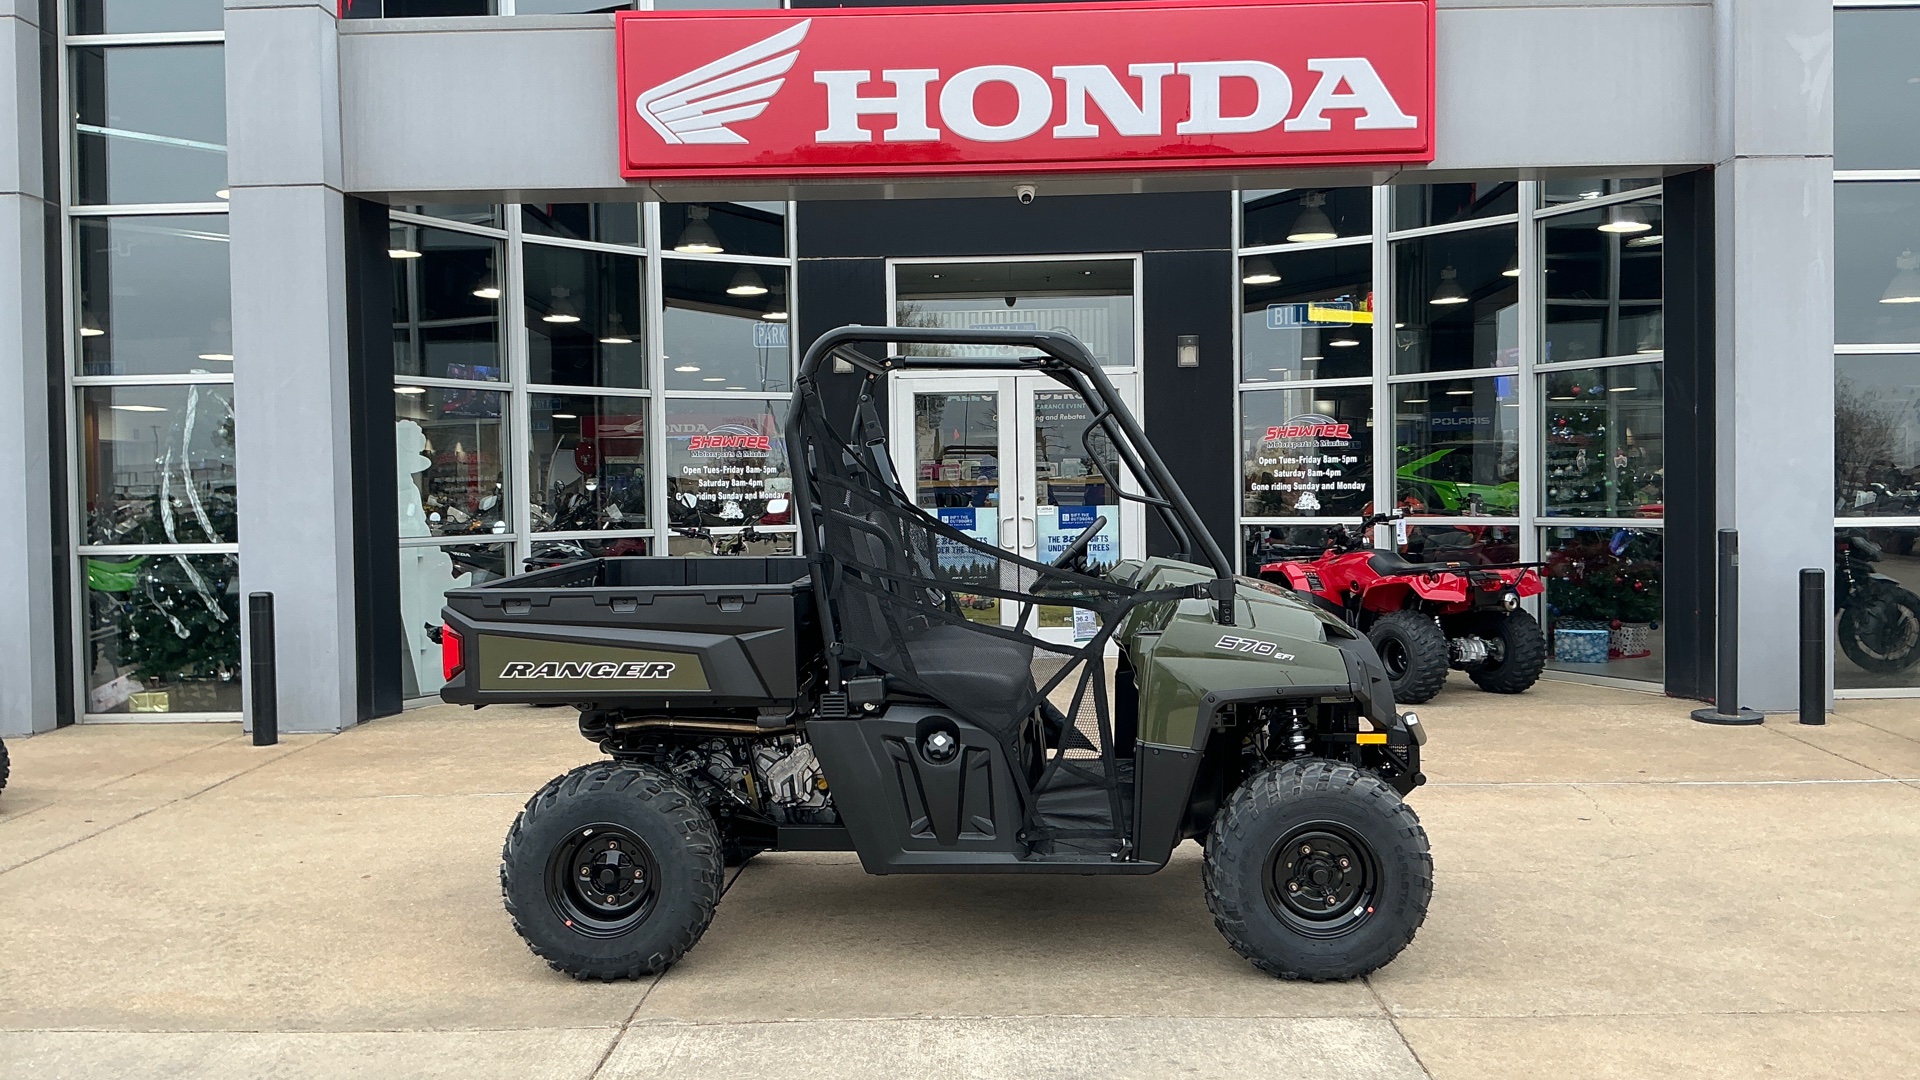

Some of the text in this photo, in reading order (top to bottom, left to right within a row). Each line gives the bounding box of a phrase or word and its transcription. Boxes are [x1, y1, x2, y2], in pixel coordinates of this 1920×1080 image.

[813, 57, 1418, 143] HONDA
[1274, 306, 1307, 325] BILL
[758, 326, 787, 345] PARK
[1060, 413, 1086, 421] Rebates
[1431, 417, 1490, 426] POLARIS
[1266, 439, 1349, 449] Motorsports & Marine
[691, 450, 770, 459] Motorsports & Marine
[1258, 454, 1358, 466] Open Tues-Friday 8am-5pm
[682, 465, 777, 475] Open Tues-Friday 8am-5pm
[1273, 468, 1342, 478] Saturday 8am-4pm
[698, 479, 763, 488] Saturday 8am-4pm
[1251, 480, 1366, 492] Gone riding Sunday and Monday
[696, 491, 785, 502] riding Sunday and Monday
[1048, 535, 1061, 543] THE
[1214, 634, 1296, 661] 570 EFI
[499, 661, 676, 679] RANGER
